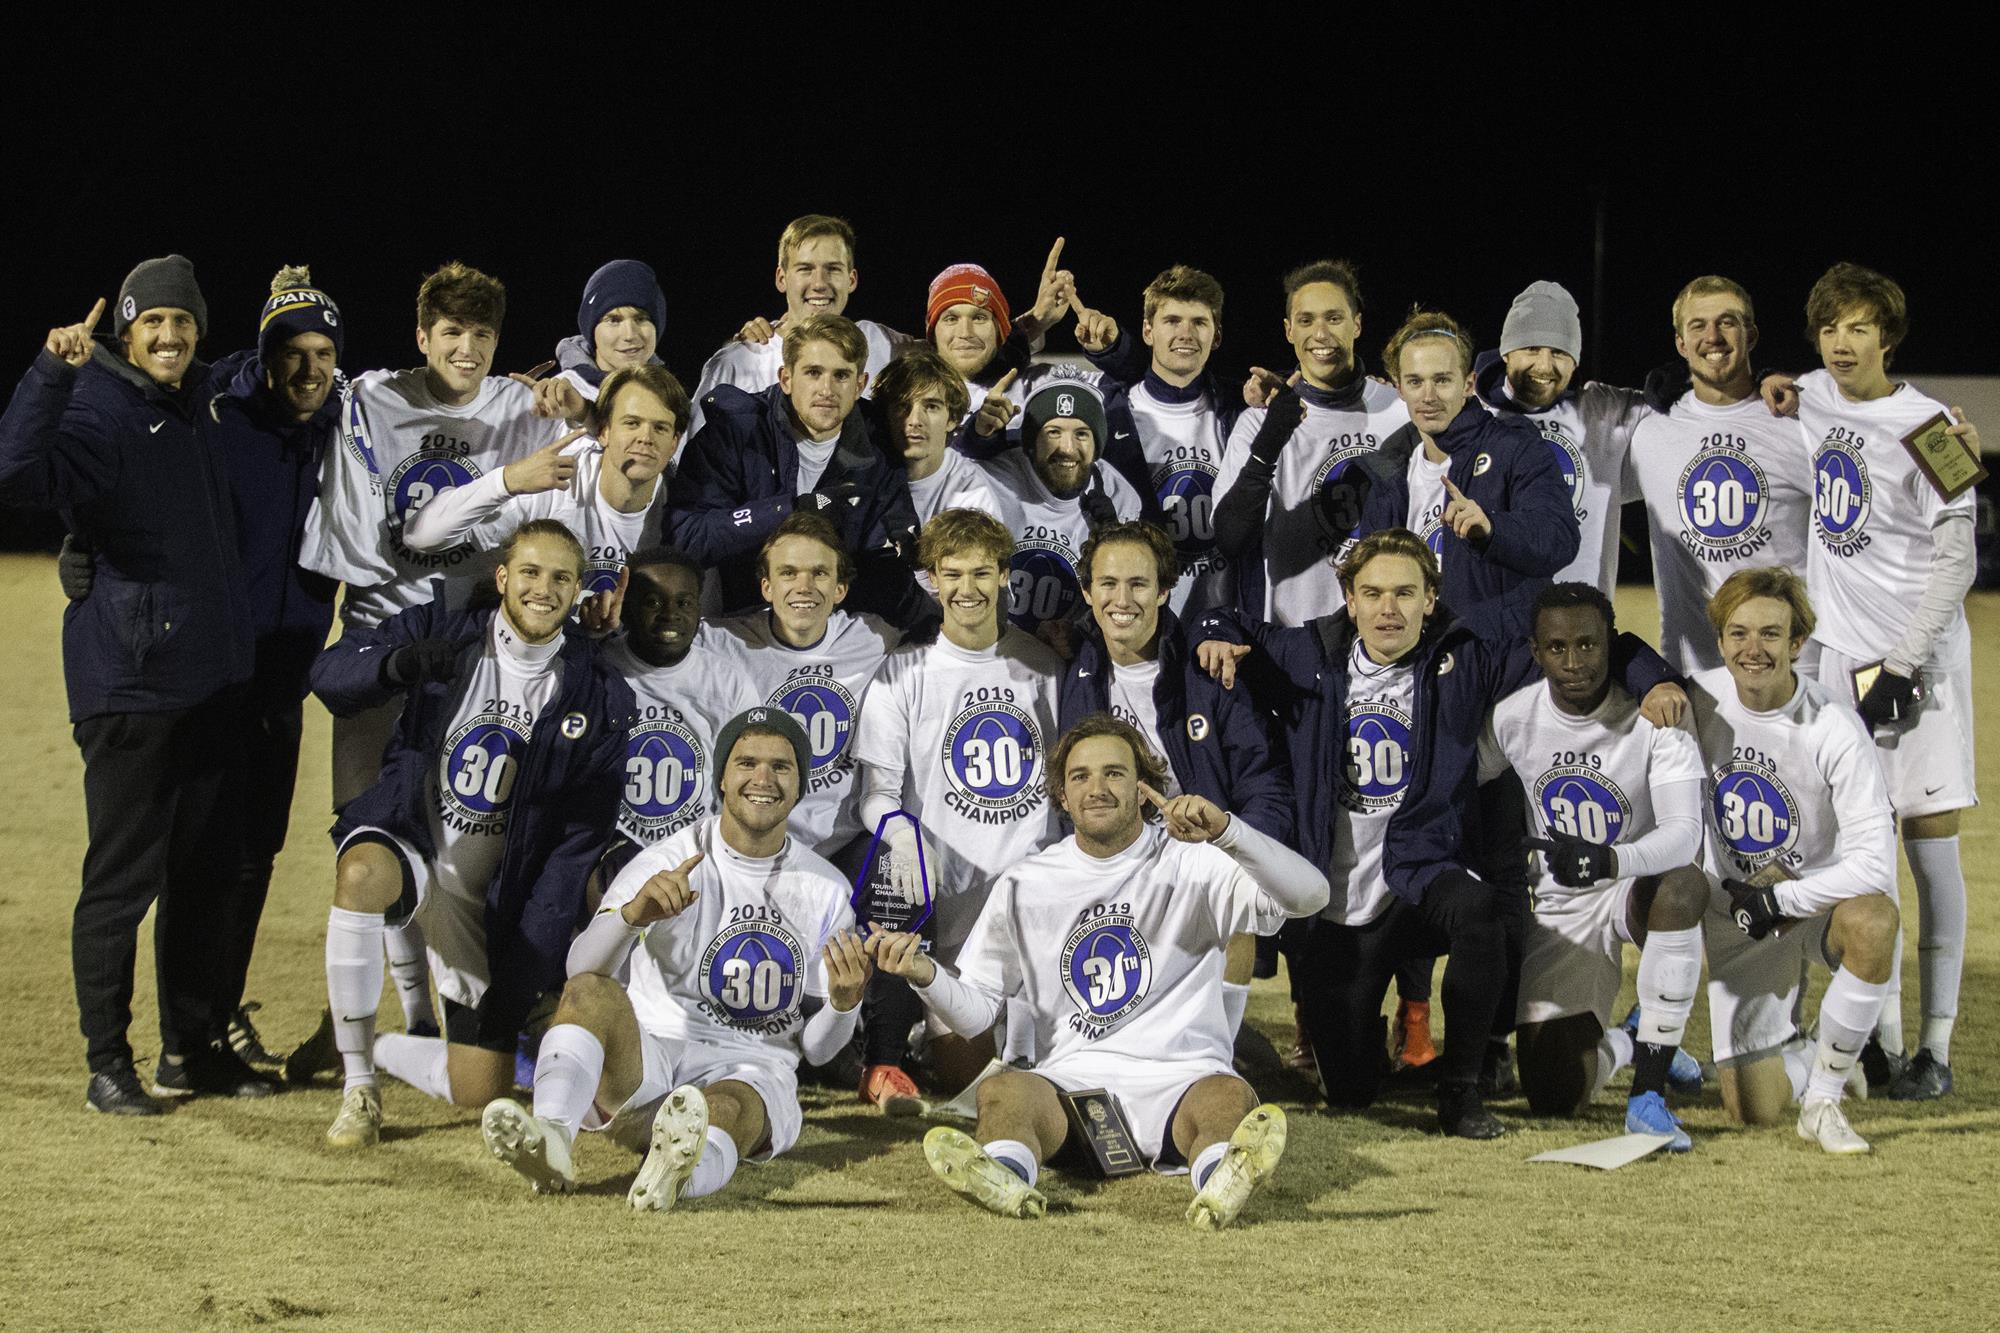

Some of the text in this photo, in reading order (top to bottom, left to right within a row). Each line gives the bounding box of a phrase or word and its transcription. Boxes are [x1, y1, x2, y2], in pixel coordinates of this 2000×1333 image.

[1537, 419, 1560, 434] 19
[419, 434, 470, 456] 2019
[1329, 432, 1376, 454] 2019
[1700, 433, 1746, 452] 2019
[1826, 427, 1864, 451] 2019
[1163, 446, 1211, 464] 2019
[1692, 480, 1758, 527] 30TH
[733, 508, 752, 527] 19
[1023, 526, 1071, 546] 2019
[1680, 526, 1772, 563] CHAMPIONS
[1052, 545, 1076, 564] ATHLETIC
[786, 664, 833, 680] 2019
[816, 678, 842, 692] ATHLETIC
[963, 686, 1015, 708] 2019
[482, 699, 533, 727] 2019
[638, 705, 684, 724] 019
[1110, 704, 1137, 729] 019
[1381, 707, 1409, 725] ATHLETIC
[629, 723, 665, 737] COLLEGIATE
[664, 724, 690, 740] ATHLETIC
[944, 732, 955, 750] LOUIS
[952, 703, 997, 733] INTERCOLLEGIATE
[997, 703, 1024, 720] ATHLETIC
[1022, 716, 1042, 753] CONFERENCE
[447, 730, 464, 749] LOUIS
[963, 736, 1033, 788] 30TH
[1552, 751, 1602, 770] 2019
[1733, 747, 1777, 773] 2019
[625, 756, 694, 806] 30TH
[1583, 769, 1609, 787] ATHLETIC
[944, 783, 1048, 825] CHAMPIONS
[977, 796, 1018, 807] ANNIVERSARY
[1019, 783, 1033, 798] 2019
[1550, 796, 1620, 845] 30TH
[1722, 791, 1788, 843] 30TH
[730, 904, 782, 924] 2019
[1080, 903, 1131, 925] 2019
[880, 921, 898, 930] 2019
[703, 948, 717, 968] LOUIS
[714, 923, 761, 949] INTERCOLLEGIATE
[761, 924, 790, 943] ATHLETIC
[1062, 953, 1072, 973] LOUIS
[1067, 918, 1111, 954] INTERCOLLEGIATE
[721, 958, 793, 1011] 30TH
[1127, 994, 1143, 1009] 2019
